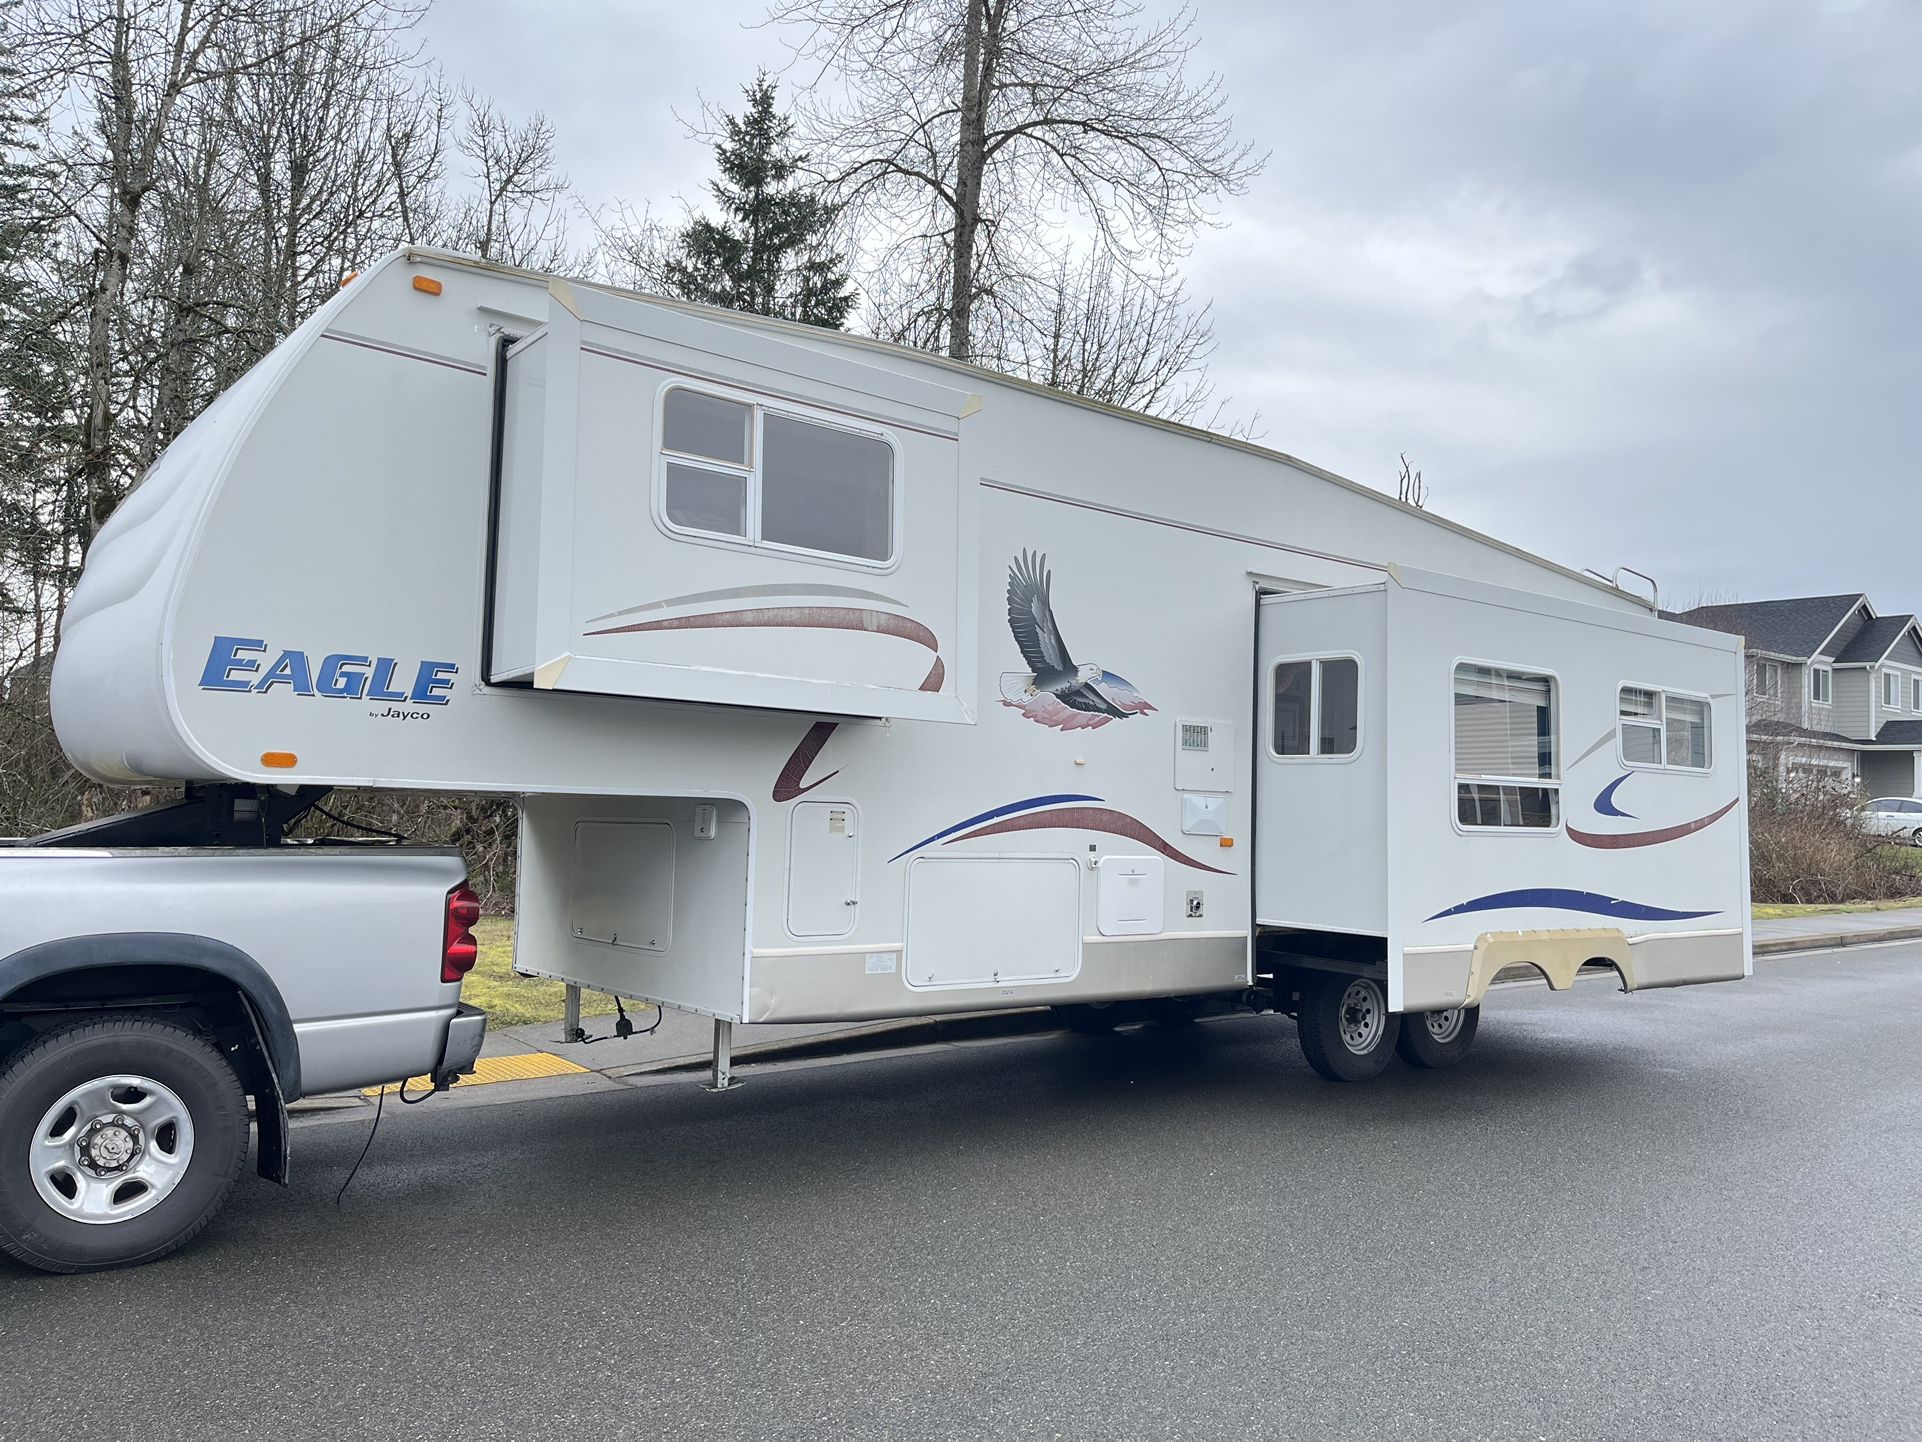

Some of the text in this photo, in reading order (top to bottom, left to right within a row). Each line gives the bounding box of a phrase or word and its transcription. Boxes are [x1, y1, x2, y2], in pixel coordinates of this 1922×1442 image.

[198, 635, 459, 706] EAGLE
[369, 706, 431, 721] by Jayco
